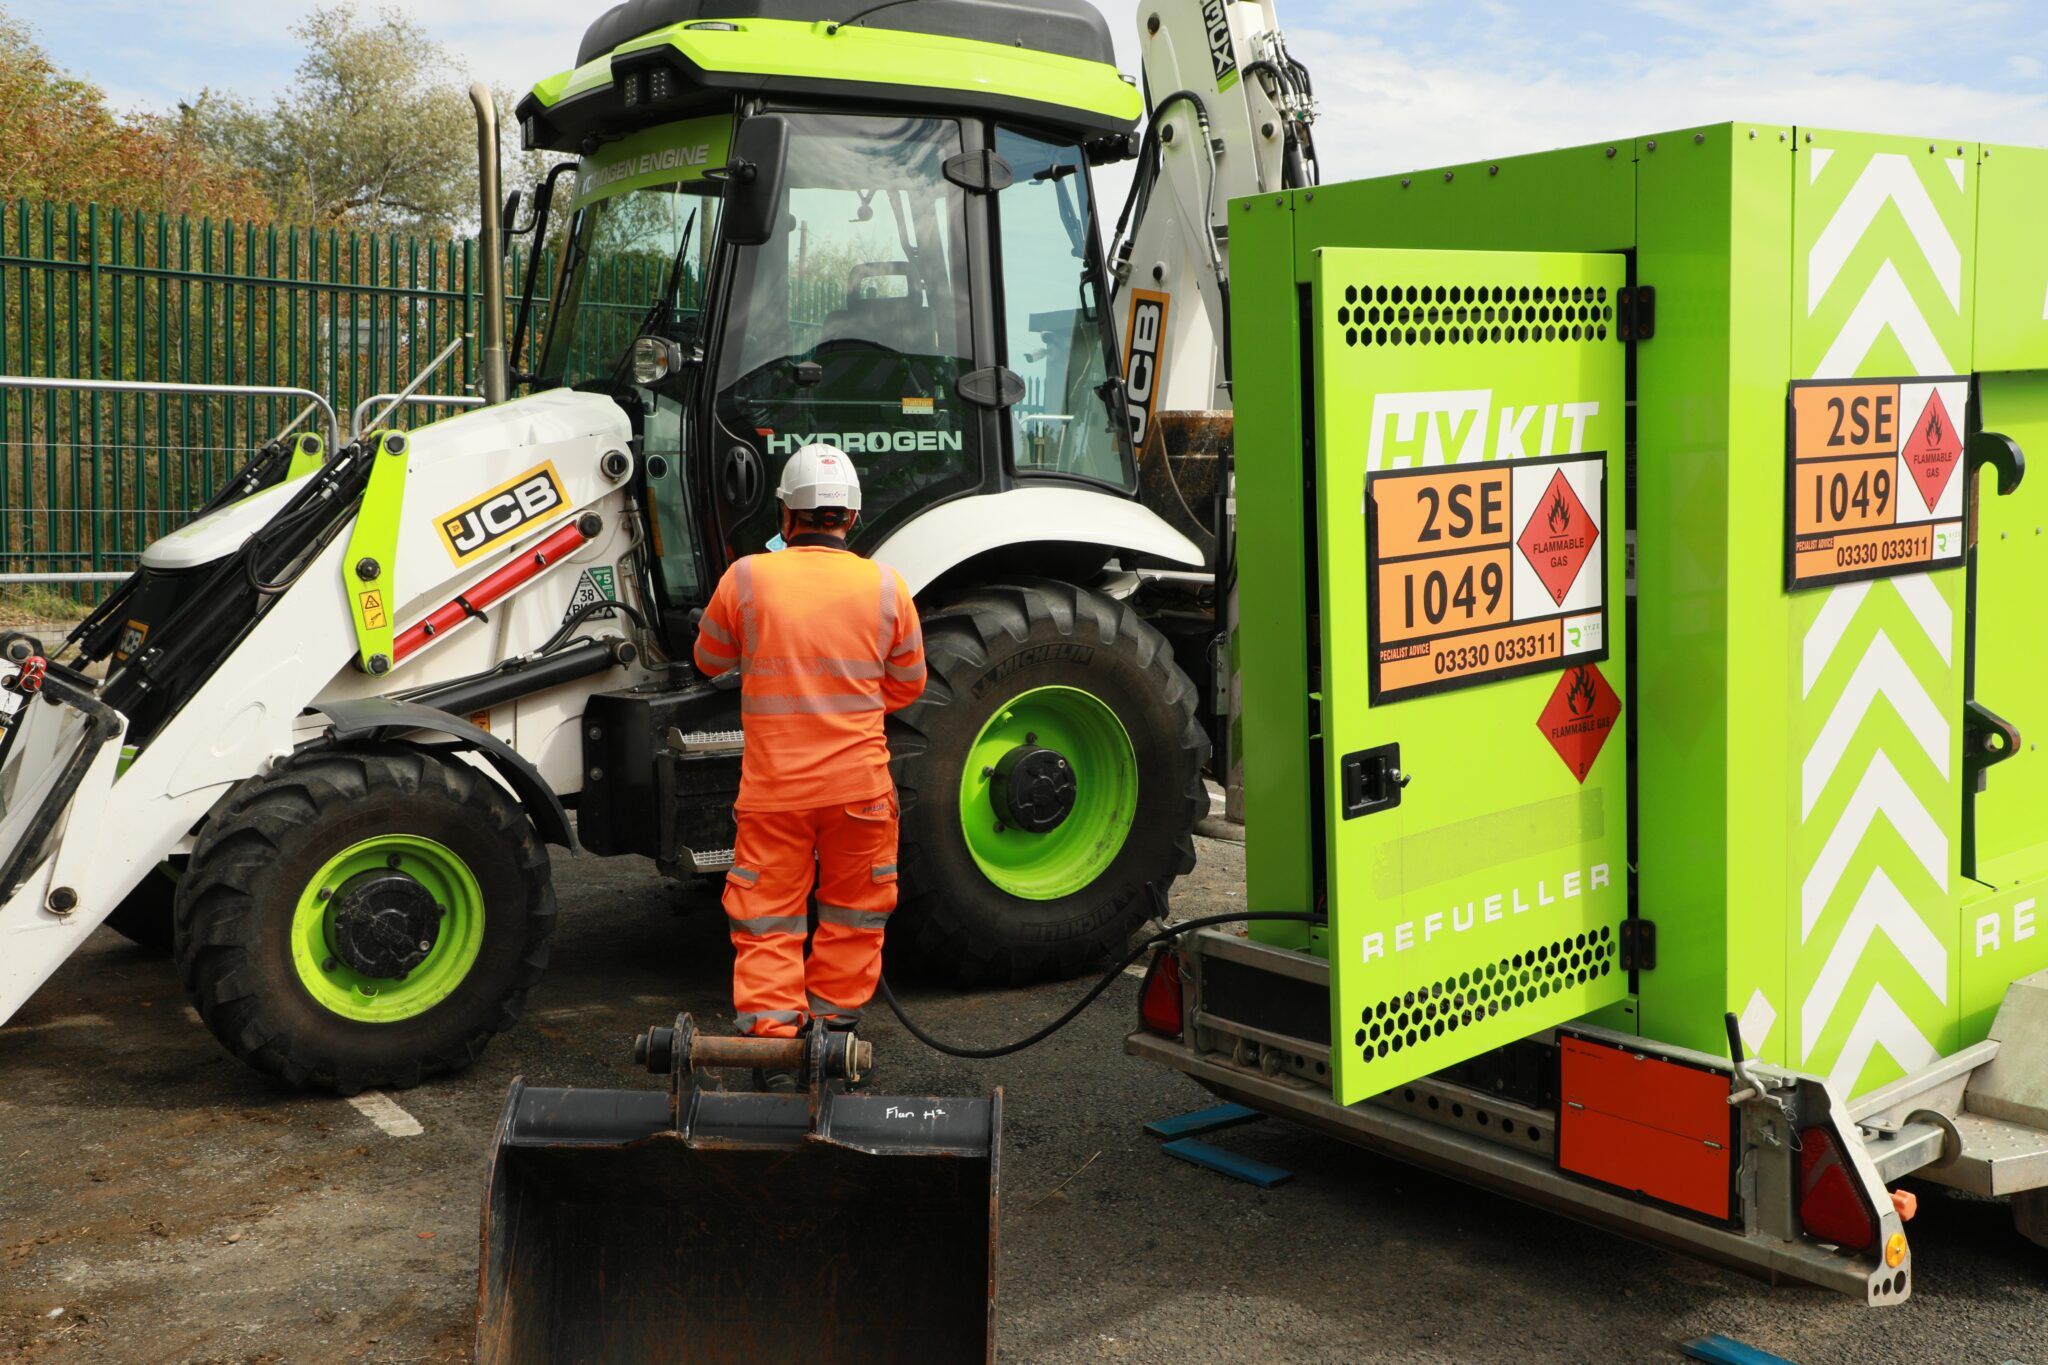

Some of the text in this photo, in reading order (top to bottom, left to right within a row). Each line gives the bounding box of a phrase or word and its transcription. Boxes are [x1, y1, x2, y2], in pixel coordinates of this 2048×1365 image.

[1203, 0, 1234, 73] 3CX
[638, 144, 709, 175] ENGINE
[1128, 304, 1160, 444] JCB
[1826, 395, 1893, 447] 2SE
[1913, 451, 1953, 465] FLAMMABLE
[1926, 467, 1940, 478] GAS
[1417, 480, 1503, 543] 2SE
[1815, 469, 1891, 524] 1049
[1929, 497, 1935, 508] 2
[455, 476, 558, 551] JCB
[1532, 537, 1585, 555] FLAMMABLE
[1836, 542, 1878, 567] 03330
[1881, 536, 1928, 561] 033311
[603, 573, 612, 584] 5
[1550, 557, 1569, 569] GAS
[579, 589, 595, 602] 38
[1404, 562, 1504, 629] 1049
[1556, 588, 1563, 600] 2
[996, 644, 1093, 680] MICHELIN
[1380, 643, 1430, 662] PECIALIST ADVICE
[1434, 631, 1556, 675] 03330 033311
[1551, 716, 1611, 739] FLAMMABLE GAS
[1579, 762, 1585, 775] 2
[1362, 863, 1610, 964] REFUELLER
